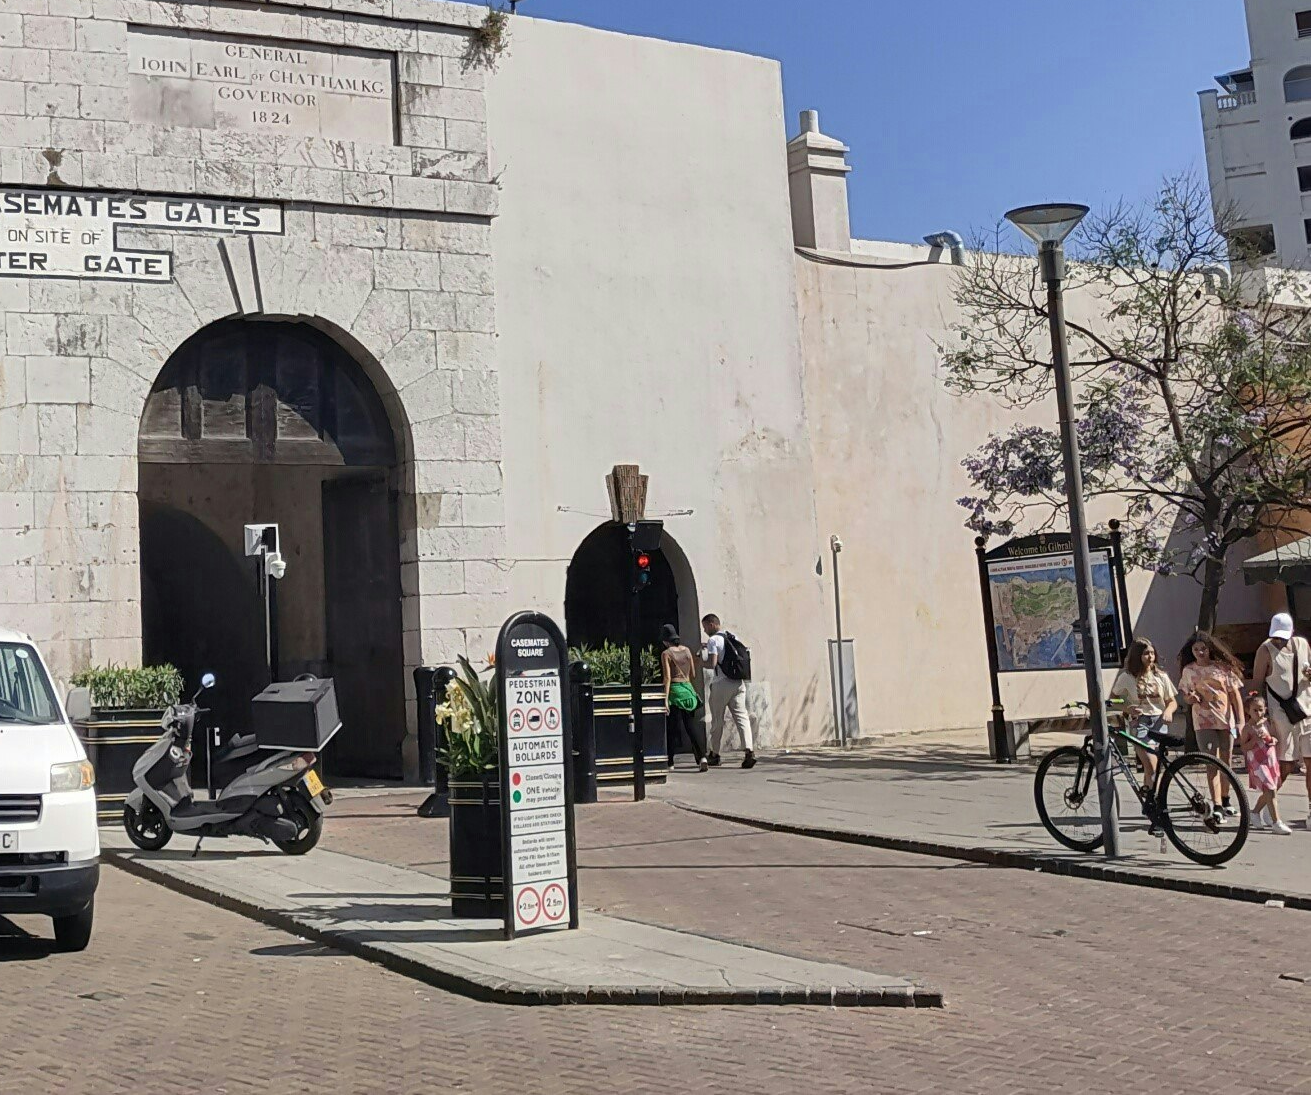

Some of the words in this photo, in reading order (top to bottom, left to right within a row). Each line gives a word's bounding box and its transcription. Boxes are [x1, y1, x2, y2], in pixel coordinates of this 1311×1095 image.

[196, 62, 246, 80] EARL
[218, 86, 317, 107] GOVERNOR
[252, 110, 291, 125] 1824
[165, 202, 261, 227] GATES
[7, 229, 28, 242] ON
[35, 230, 71, 244] SITE
[80, 232, 102, 245] OF
[84, 255, 163, 275] GATE
[1007, 545, 1039, 557] Welcome
[1039, 545, 1048, 554] to
[510, 638, 550, 648] CASEMATES
[517, 648, 544, 657] SQUARE
[508, 679, 557, 689] PEDESTRIAN
[516, 690, 551, 704] ZONE
[512, 740, 559, 751] AUTOMATIC
[515, 751, 557, 762] BOLLARDS
[526, 785, 541, 795] ONE
